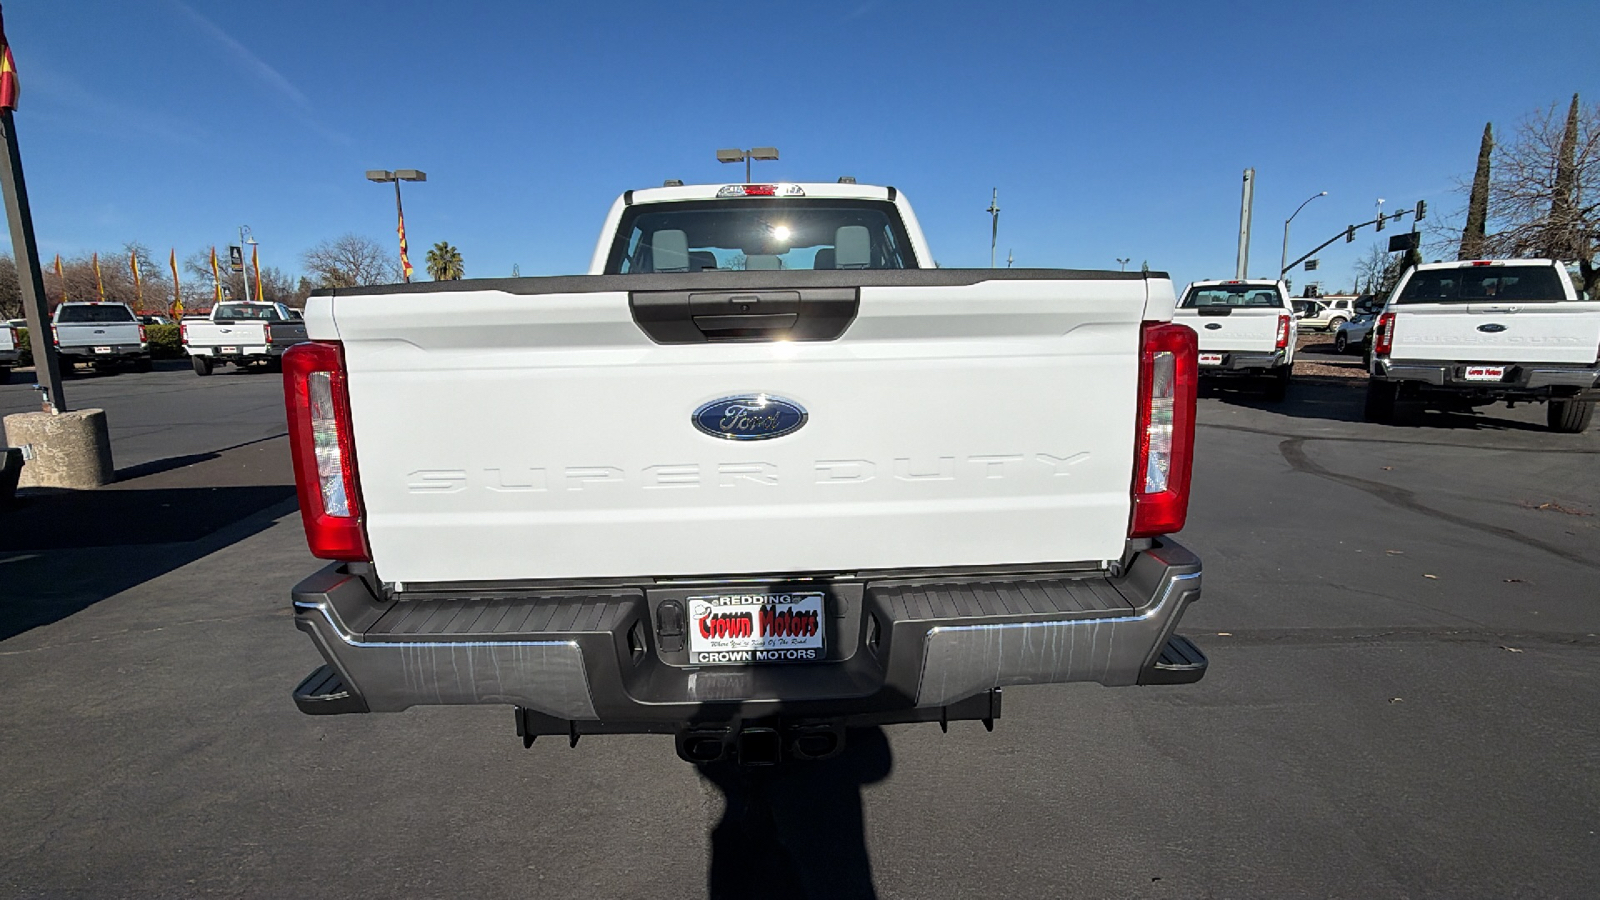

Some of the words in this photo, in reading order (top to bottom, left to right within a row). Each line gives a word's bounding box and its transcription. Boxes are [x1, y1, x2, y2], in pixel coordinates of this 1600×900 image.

[719, 404, 781, 430] Ford
[407, 462, 778, 494] SUPER
[815, 451, 1091, 483] DUTY
[720, 595, 791, 605] REDDING
[699, 608, 753, 640] Crown
[759, 605, 819, 638] Motors
[699, 651, 752, 662] CROWN
[756, 649, 816, 661] MOTORS
